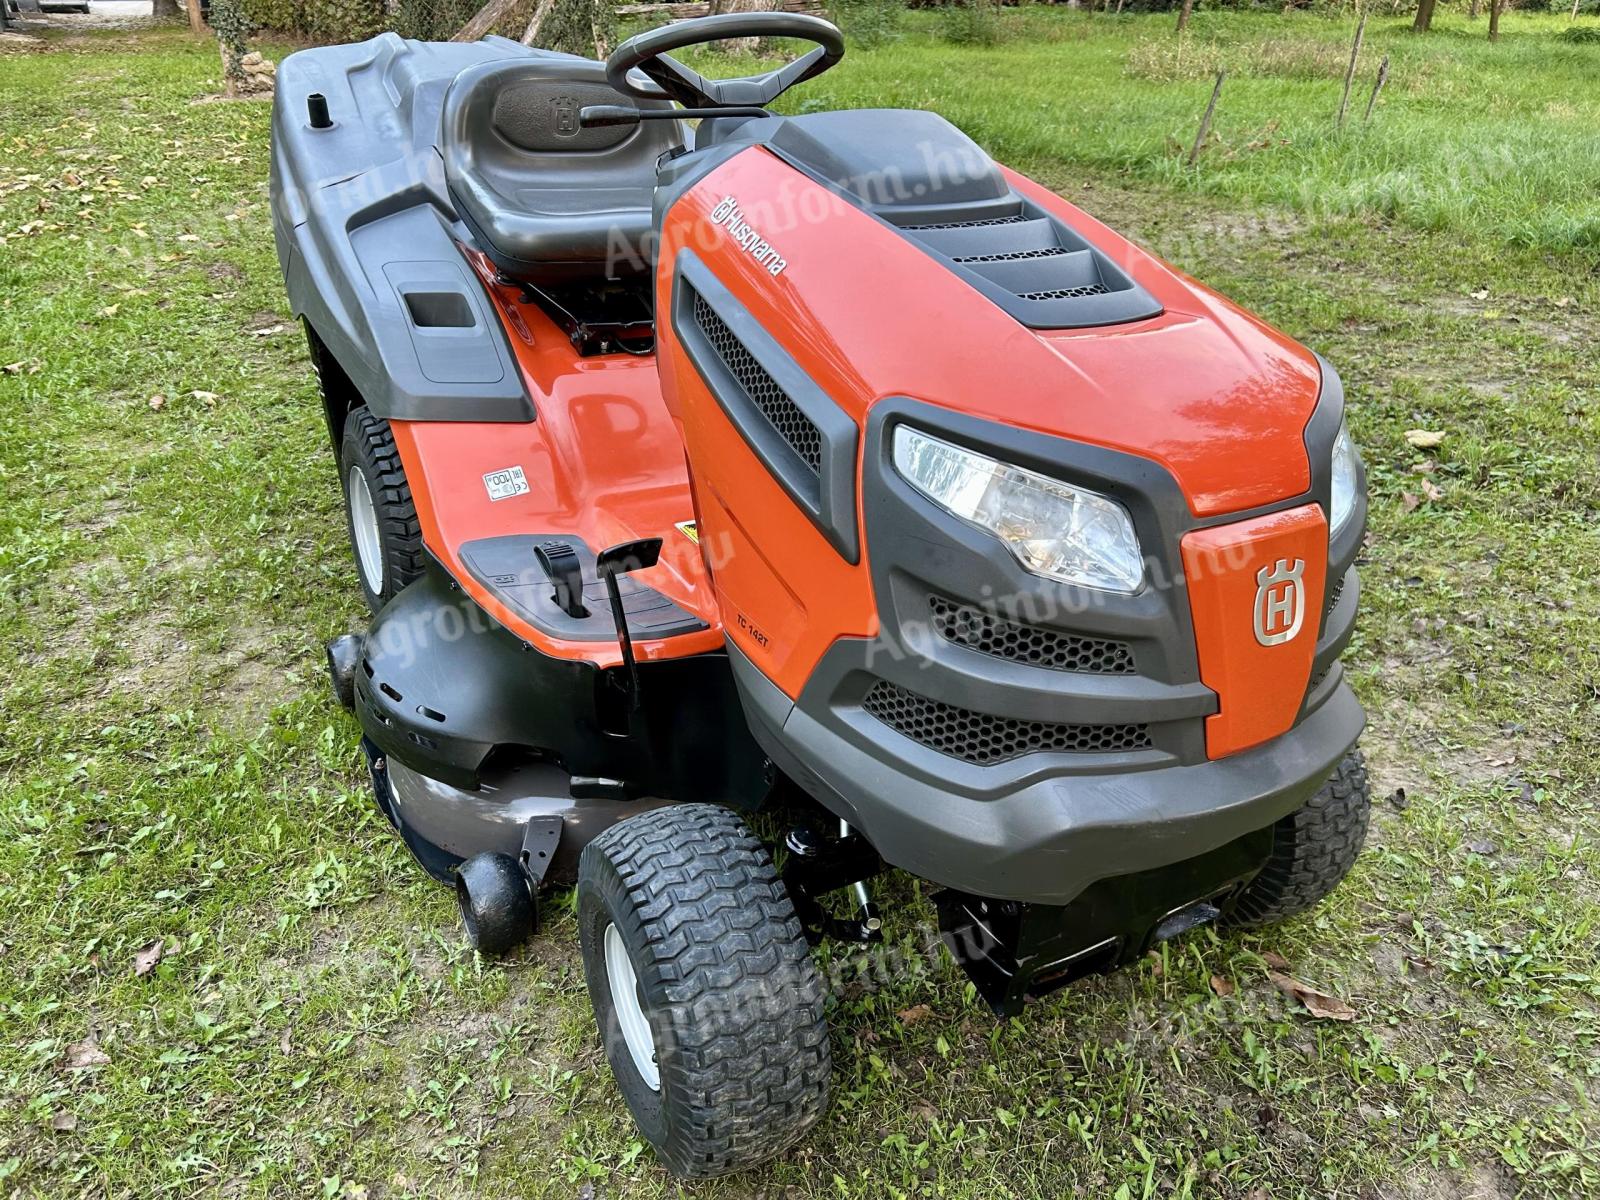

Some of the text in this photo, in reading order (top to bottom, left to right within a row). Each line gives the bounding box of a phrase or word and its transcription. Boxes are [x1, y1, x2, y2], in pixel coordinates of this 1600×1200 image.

[722, 207, 787, 277] Husqvarna
[737, 613, 769, 648] TC 142T
